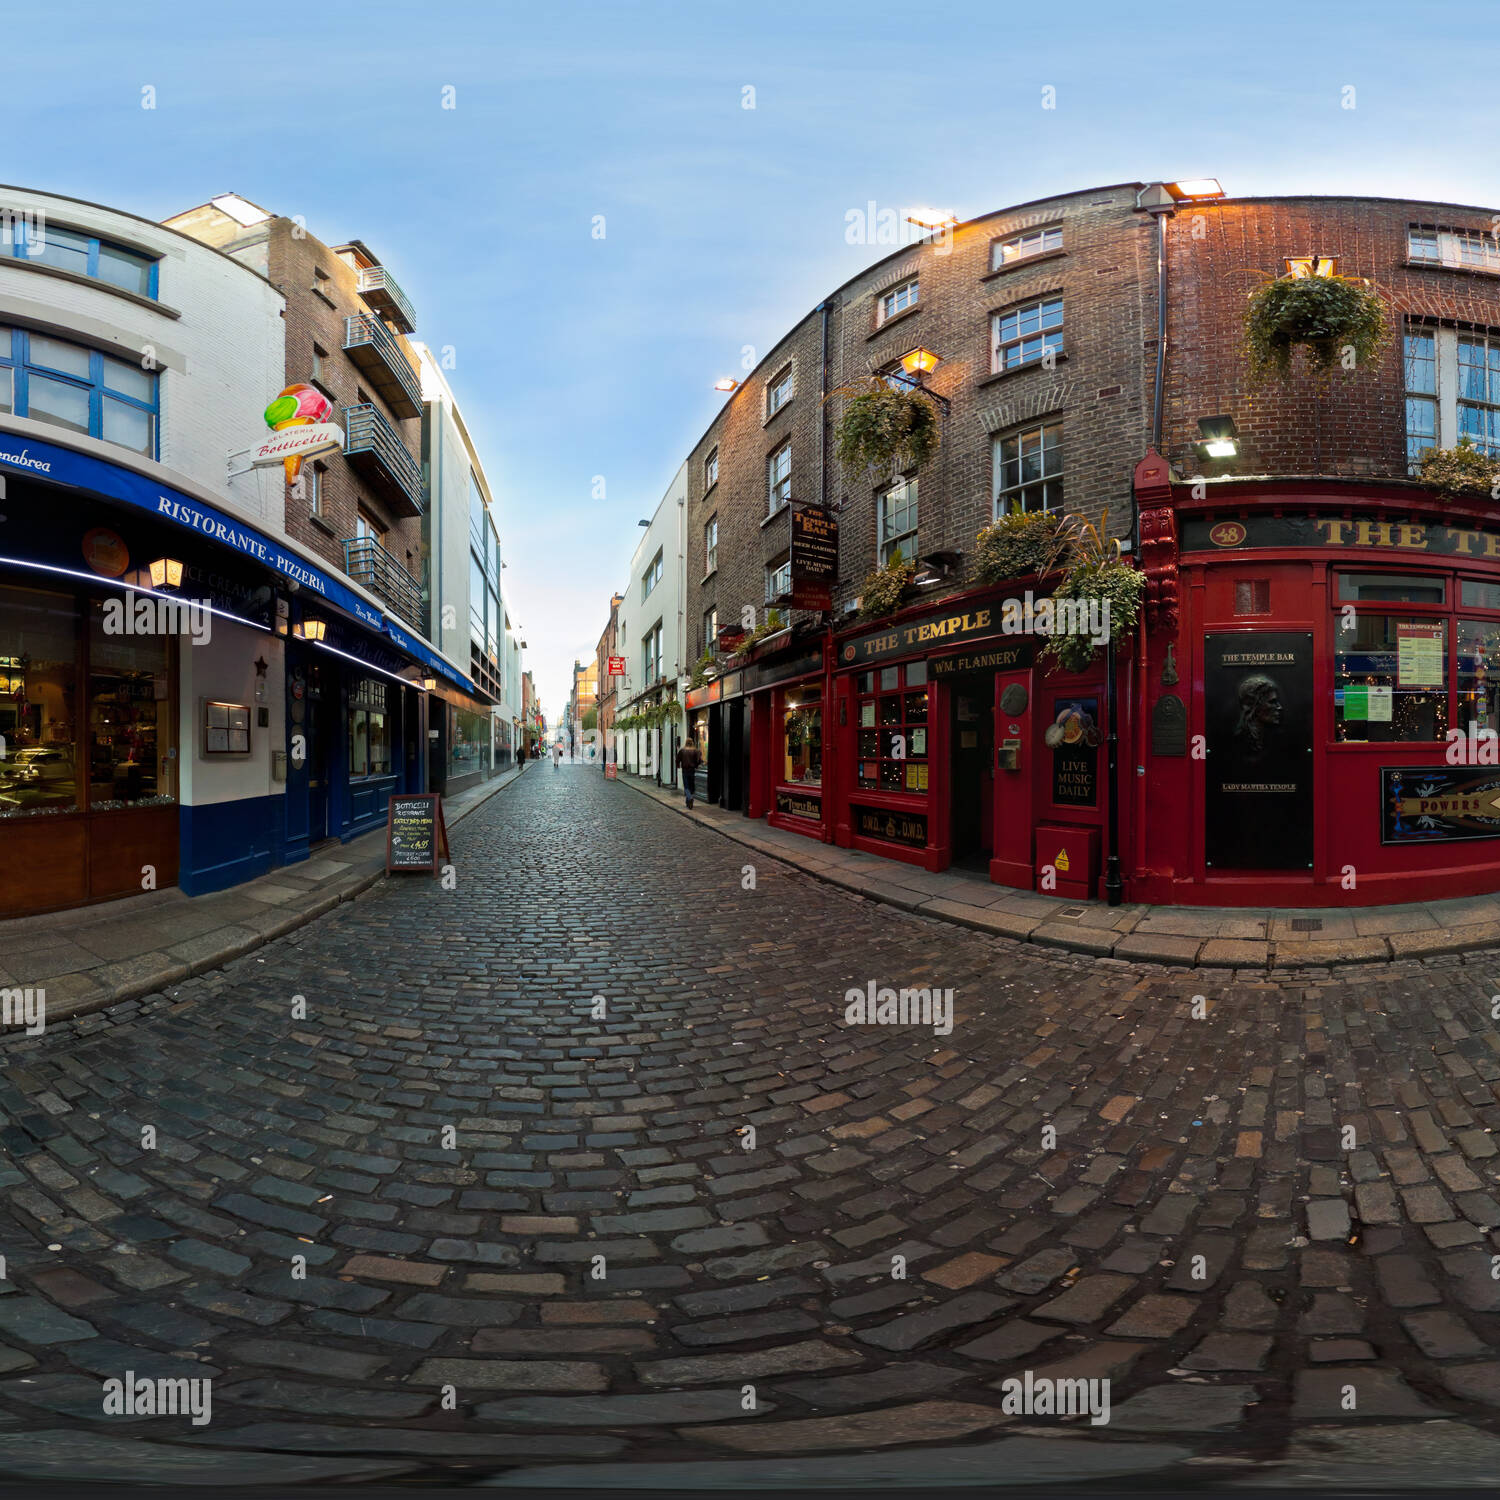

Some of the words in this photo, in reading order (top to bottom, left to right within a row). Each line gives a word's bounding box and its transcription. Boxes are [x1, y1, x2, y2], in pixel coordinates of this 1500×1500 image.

[267, 428, 314, 443] GELATERIA
[256, 433, 330, 457] Botticelli
[808, 509, 824, 517] THE
[793, 512, 838, 531] TEMPLE
[803, 520, 828, 536] BAR
[1216, 527, 1239, 544] 48
[1317, 519, 1429, 550] THE
[157, 496, 268, 561] RISTORANTE
[276, 554, 327, 595] PIZZERIA
[796, 558, 812, 567] LIVE
[813, 561, 833, 570] MUSIC
[805, 566, 825, 574] DAILY
[864, 633, 899, 656] THE
[904, 610, 992, 645] TEMPLE
[958, 649, 1020, 670] FLANNERY
[1222, 654, 1240, 662] THE
[1240, 653, 1276, 662] TEMPLE
[1276, 653, 1295, 661] BAR
[1062, 761, 1088, 772] LIVE
[1057, 773, 1093, 785] MUSIC
[1058, 785, 1091, 797] DAILY
[1222, 783, 1240, 791] LADY
[1240, 783, 1270, 791] MARTHA
[1269, 783, 1297, 791] TEMPLE
[1420, 797, 1480, 813] POWERS
